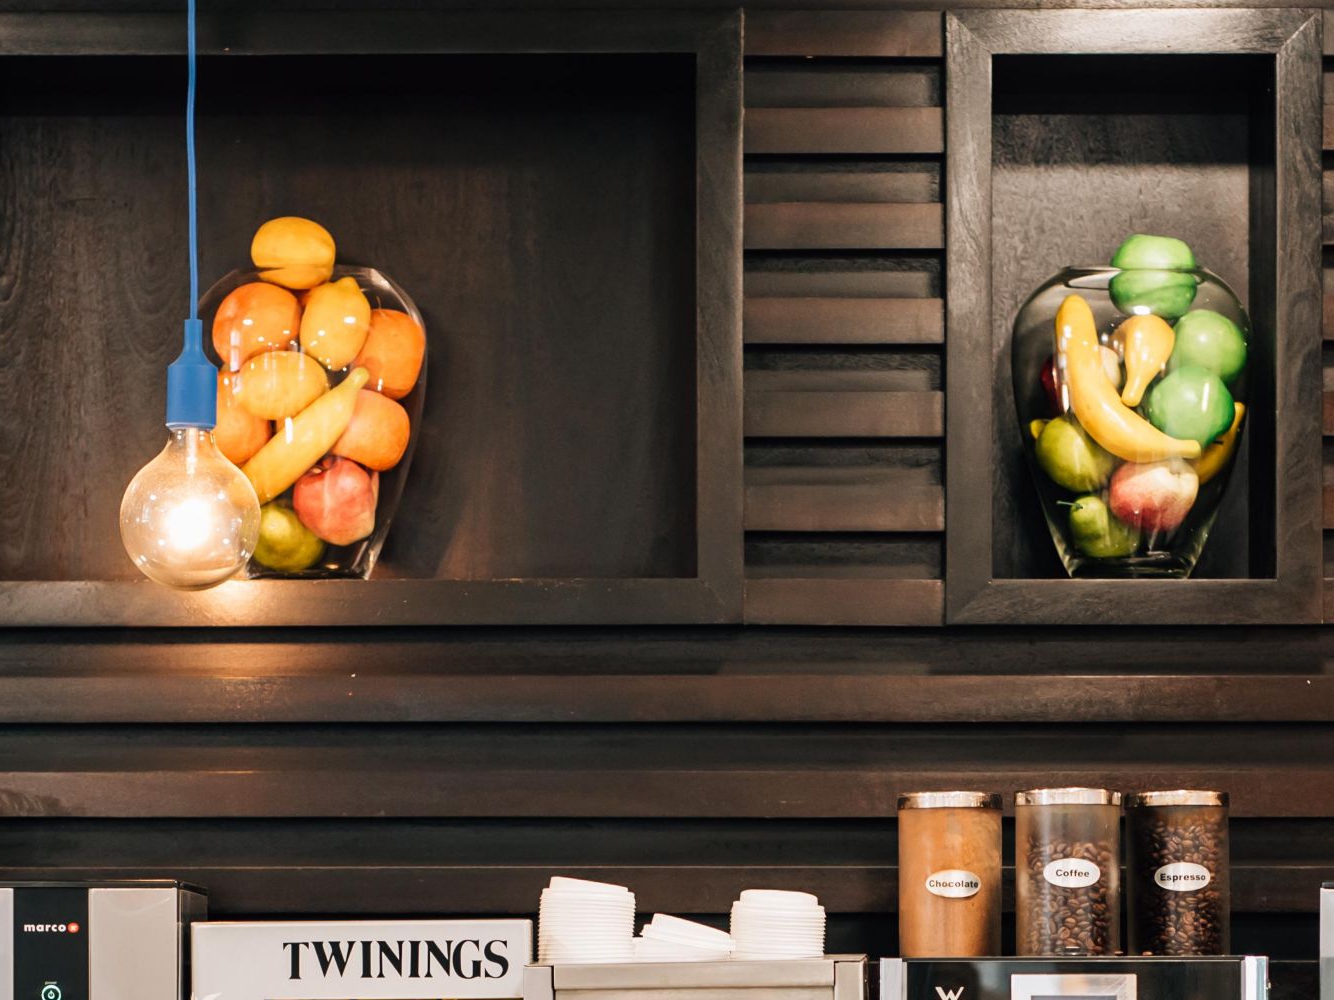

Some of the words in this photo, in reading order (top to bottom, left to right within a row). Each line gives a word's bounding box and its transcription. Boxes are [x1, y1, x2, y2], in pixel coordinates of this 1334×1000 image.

[1055, 868, 1090, 878] Coffee
[1159, 873, 1206, 883] Espresso
[928, 879, 979, 889] Chocolate
[23, 924, 67, 932] marco
[282, 938, 510, 980] TWININGS
